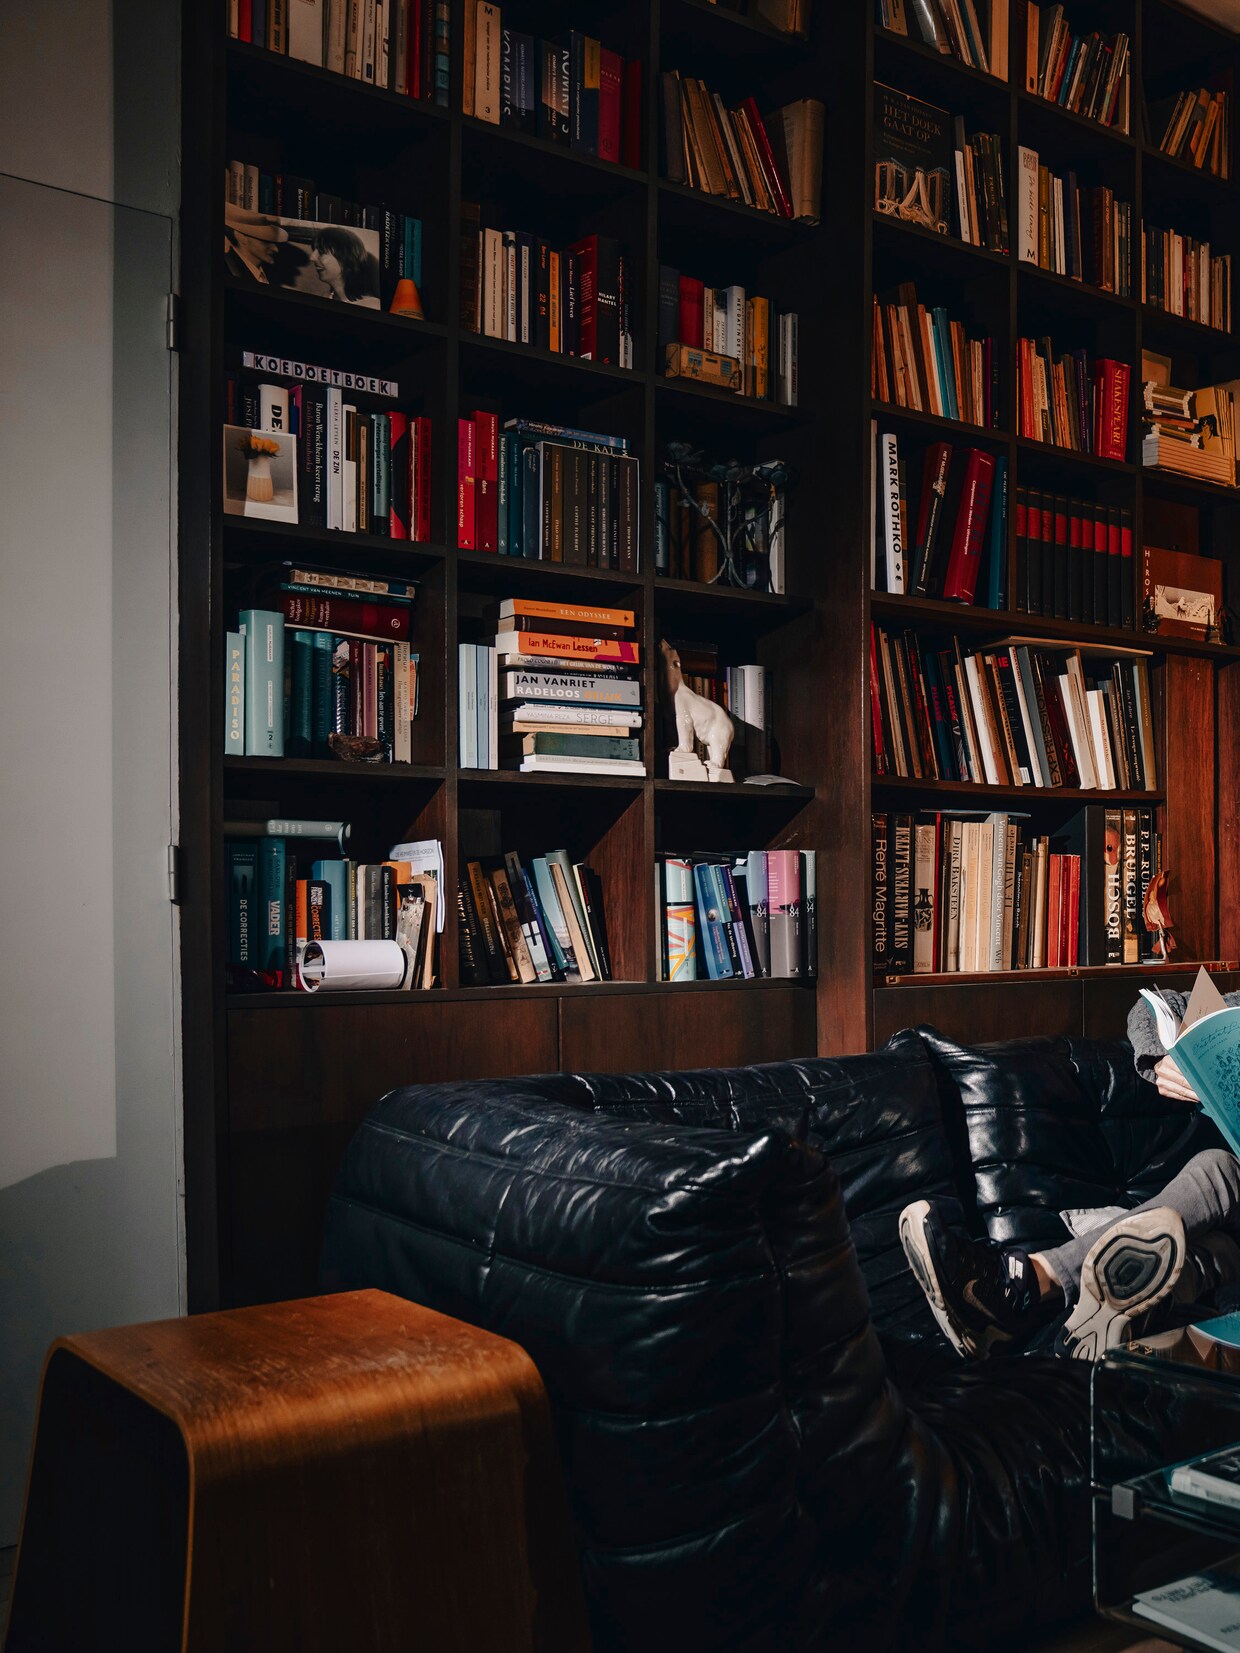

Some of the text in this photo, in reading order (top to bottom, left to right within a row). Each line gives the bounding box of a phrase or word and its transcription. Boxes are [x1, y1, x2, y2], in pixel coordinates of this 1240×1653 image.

[484, 6, 494, 16] M
[884, 104, 910, 122] HET
[912, 116, 941, 136] DOEK
[884, 117, 931, 142] GAAT OP
[1027, 248, 1036, 259] M
[598, 298, 617, 306] MANTEL
[255, 356, 388, 394] KOEDOETBOEK
[1112, 368, 1122, 447] SHAKESPEARE
[333, 450, 340, 460] DE
[573, 440, 588, 450] DE
[888, 442, 901, 554] MARK ROTHKO
[577, 611, 611, 620] ODYSSEE
[528, 638, 598, 653] Ian McEwan Lessen
[230, 649, 240, 740] PARADISO
[516, 675, 596, 688] JAN VANRIET
[516, 687, 580, 698] RADELOOS
[946, 685, 958, 721] PICASSO
[576, 714, 614, 724] SERGE
[894, 827, 910, 949] SINT-MARTENS-LATEM
[950, 837, 960, 920] DIRK BAKSTEEN
[995, 869, 1003, 891] Gogh
[1125, 834, 1136, 919] BRUEGEL
[873, 839, 888, 952] René Magritte
[1107, 873, 1120, 940] BOSCH
[240, 899, 248, 961] DE CORRECTIES
[270, 900, 280, 935] VADER
[310, 906, 322, 941] CORRECTIES
[994, 914, 1003, 945] Vincent
[729, 936, 737, 958] aardbeving
